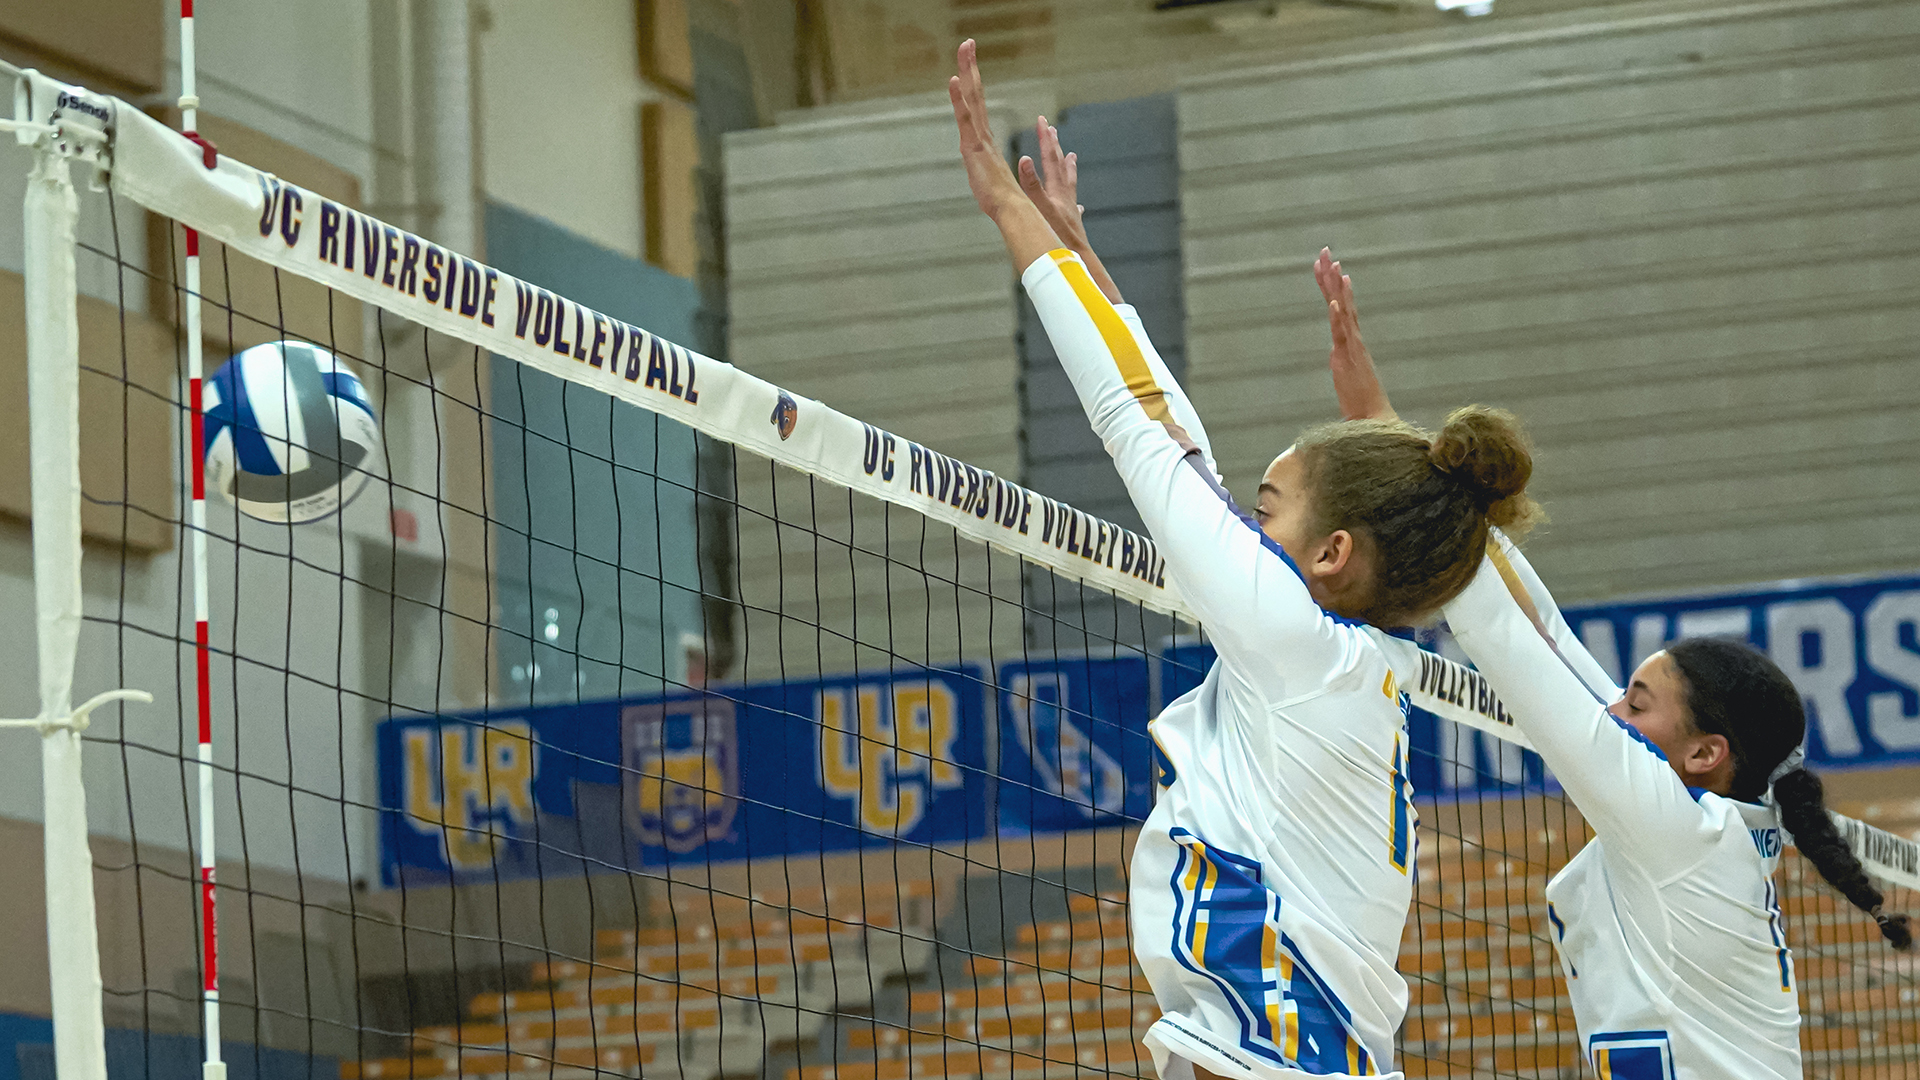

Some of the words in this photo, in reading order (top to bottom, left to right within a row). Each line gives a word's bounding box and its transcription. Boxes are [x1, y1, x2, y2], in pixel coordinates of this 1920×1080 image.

[257, 173, 303, 248] UC
[319, 200, 499, 329] RIVERSIDE
[514, 278, 699, 407] VOLLEYBALL
[862, 421, 896, 483] UC
[909, 440, 1033, 536] RIVERSIDE
[1041, 496, 1166, 590] VOLLEYBALL
